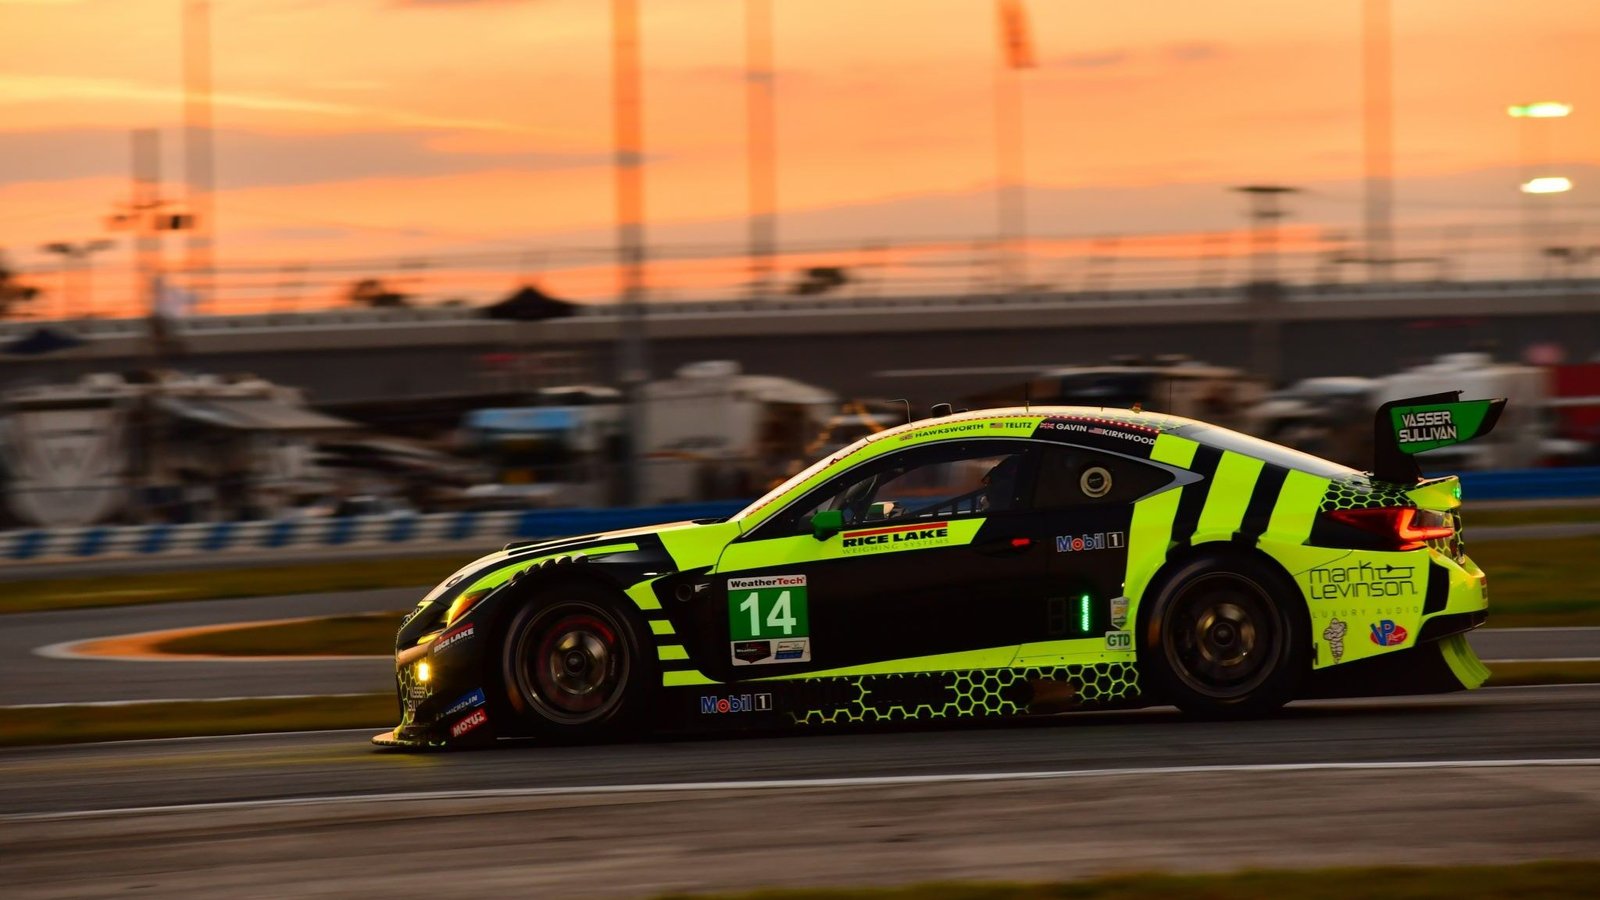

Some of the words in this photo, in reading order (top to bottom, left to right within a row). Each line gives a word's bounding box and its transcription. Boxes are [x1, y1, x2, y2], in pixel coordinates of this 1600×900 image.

[1402, 411, 1452, 428] VASSER
[915, 423, 984, 438] HAWKSWORTH
[1056, 423, 1087, 432] GAVIN
[1102, 428, 1156, 446] KIRKWOOD
[1399, 426, 1457, 443] SULLIVAN
[842, 544, 898, 554] WEIGHING
[903, 538, 949, 549] SYSTEMS
[843, 534, 888, 548] RICE
[893, 528, 948, 542] LAKE
[1056, 533, 1105, 552] Mobil
[1310, 560, 1375, 584] mark
[731, 577, 805, 588] WeatherTech
[740, 590, 797, 636] 14
[1313, 609, 1366, 619] LUXURY
[1376, 606, 1419, 615] AUDIO
[450, 628, 474, 643] LAKE
[1107, 634, 1130, 646] GTD
[701, 694, 752, 713] Mobil
[453, 711, 484, 737] MOTUL
